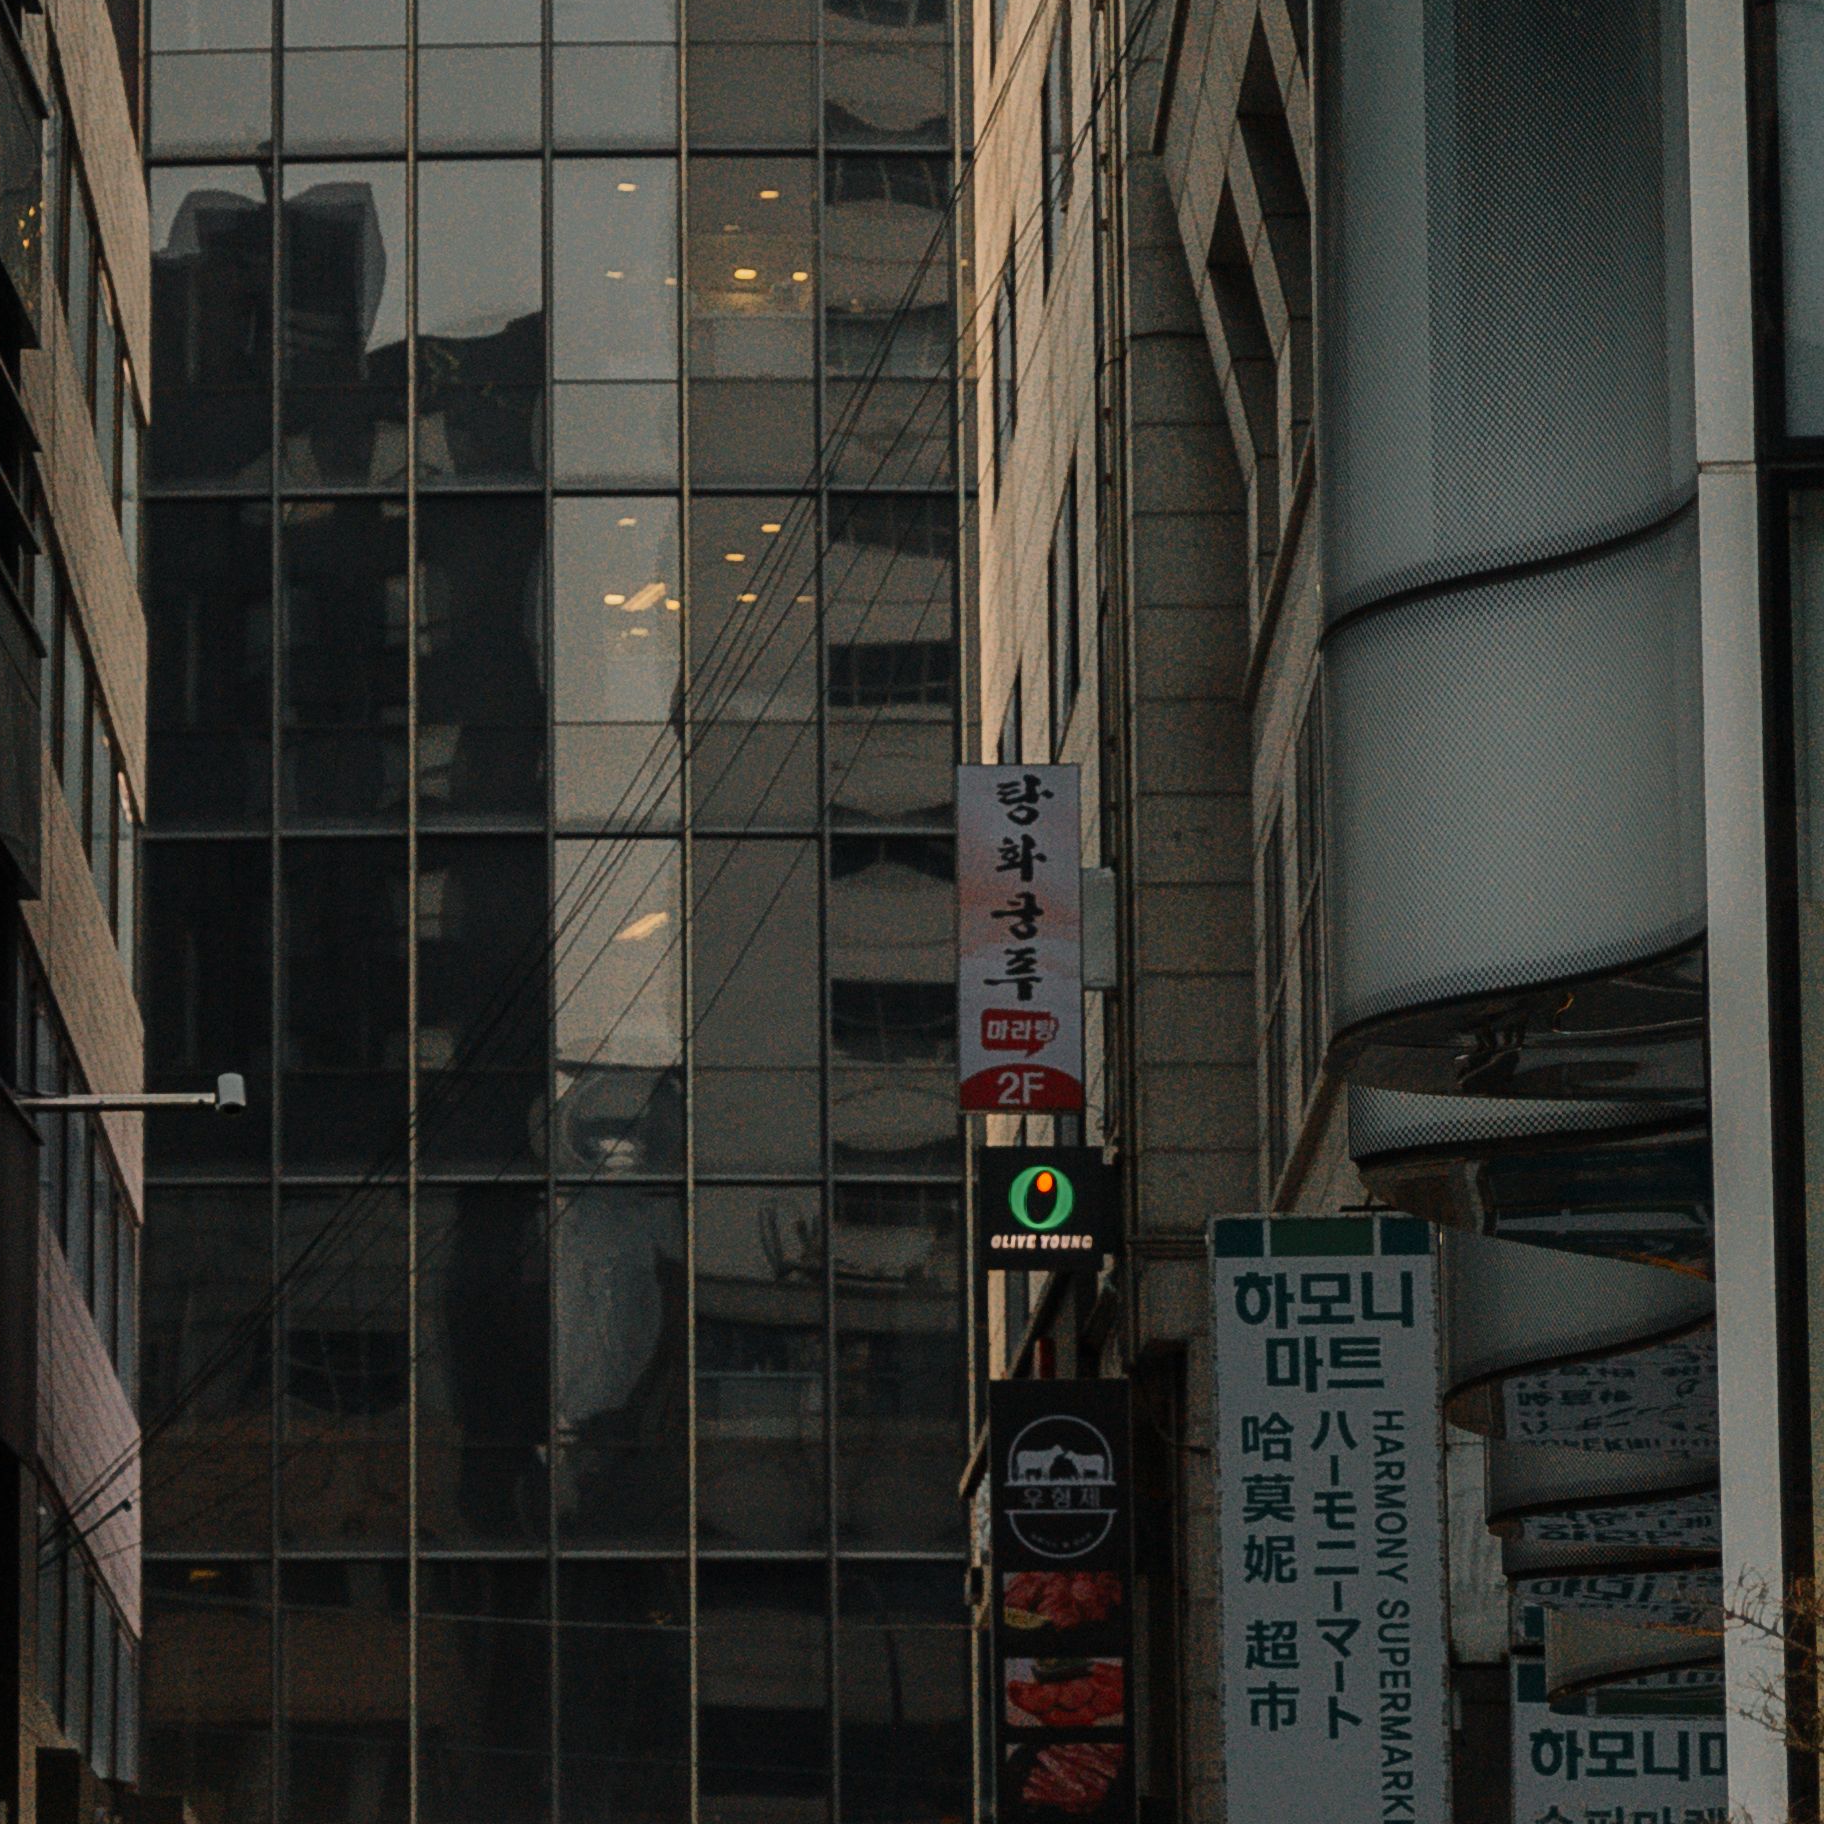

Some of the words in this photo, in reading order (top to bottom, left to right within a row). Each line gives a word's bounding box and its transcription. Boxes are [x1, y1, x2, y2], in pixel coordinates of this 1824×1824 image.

[986, 1016, 1059, 1044] 마라탕
[996, 1070, 1047, 1106] 2F
[989, 1233, 1038, 1251] OLIVE
[1039, 1233, 1095, 1251] YOUNG
[1233, 1271, 1415, 1329] 하모니
[1265, 1335, 1384, 1393] 마트
[1240, 1411, 1298, 1584] 哈莫妮
[1373, 1409, 1409, 1584] HARMONY
[1310, 1410, 1363, 1740] ハーモニーマート
[1244, 1619, 1301, 1732] 超市
